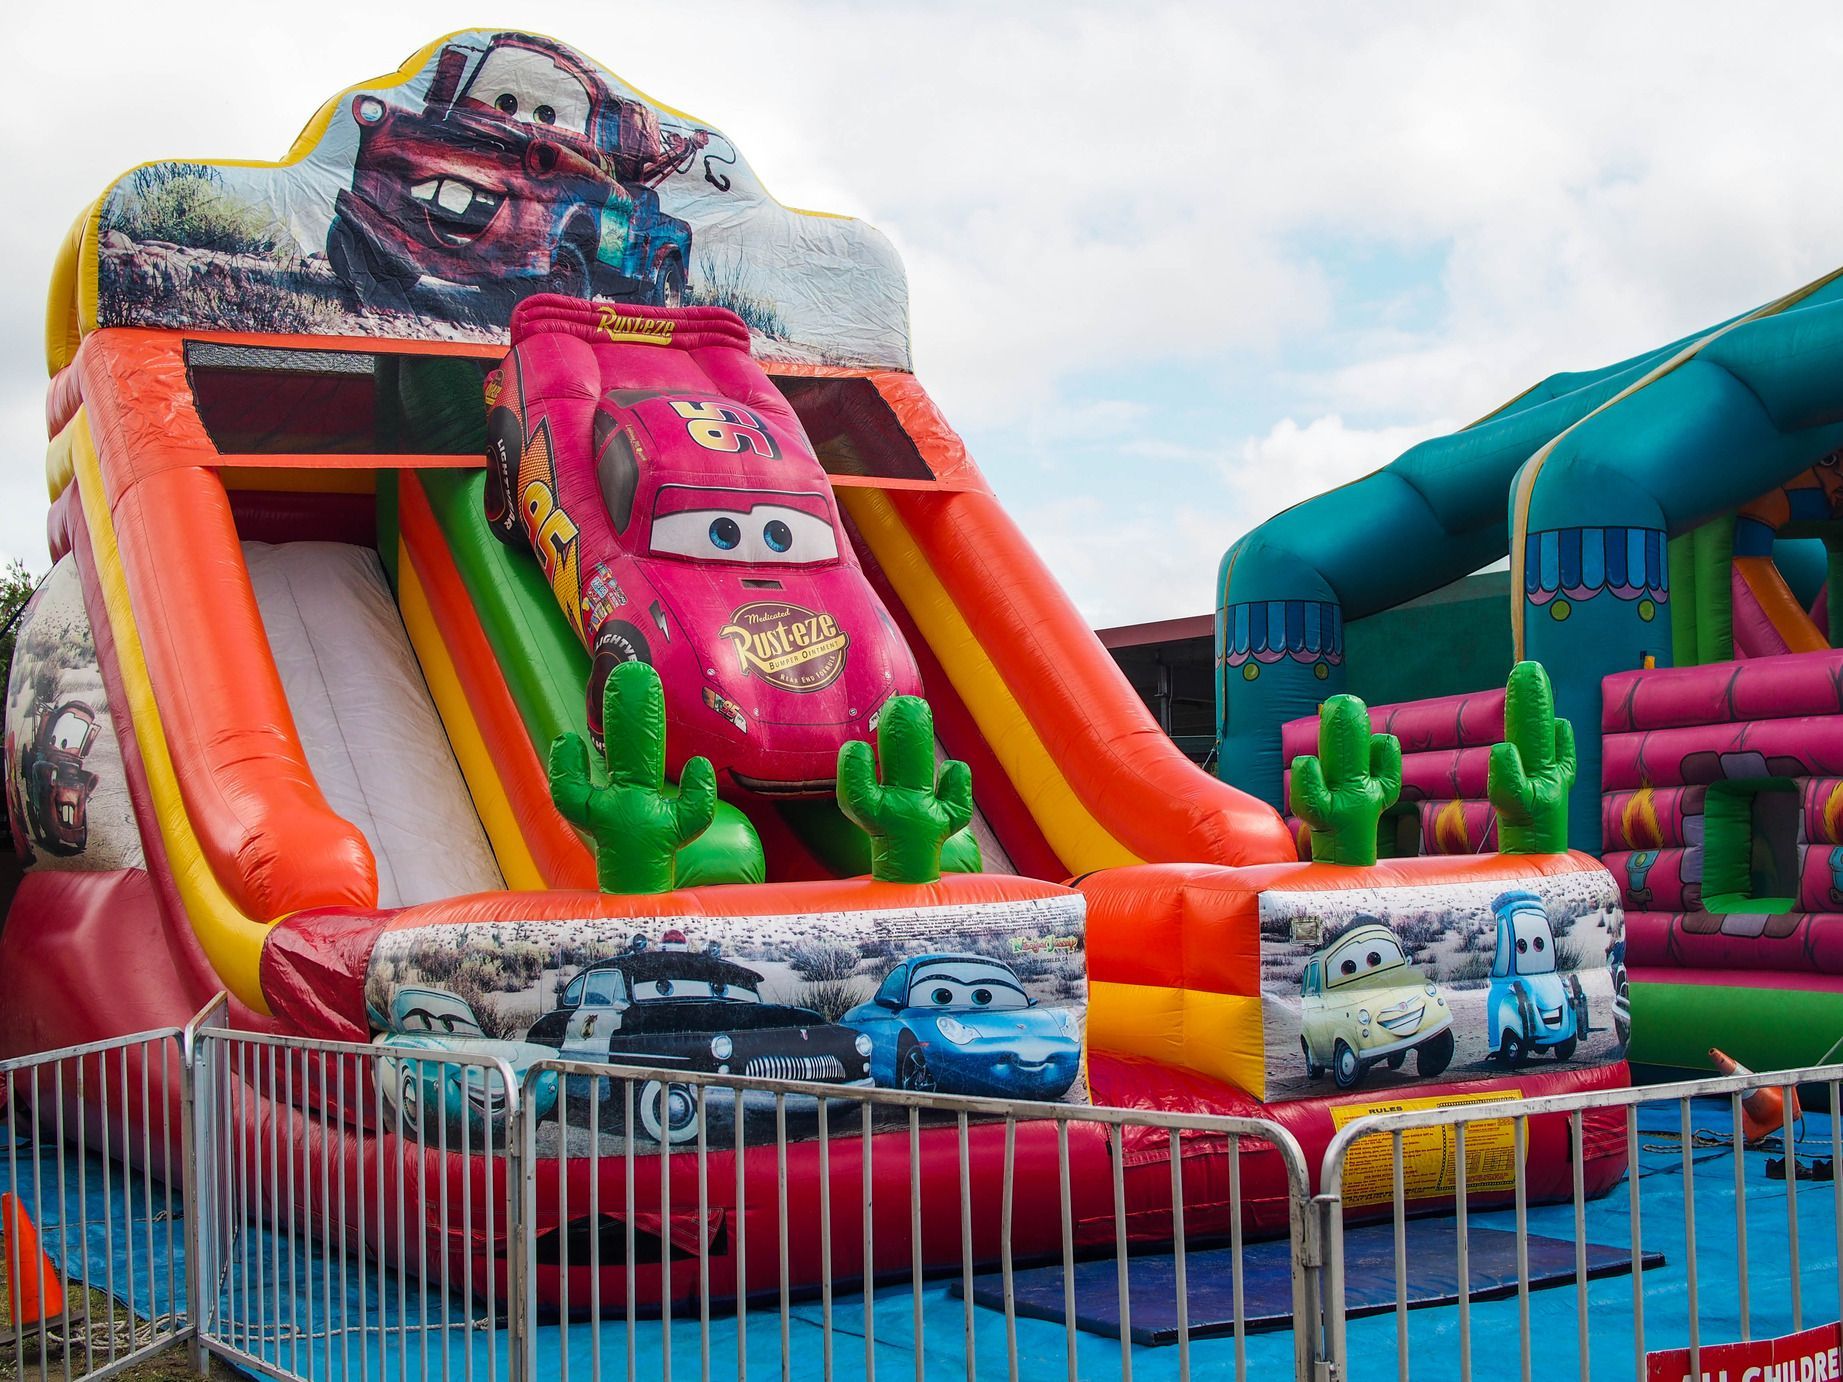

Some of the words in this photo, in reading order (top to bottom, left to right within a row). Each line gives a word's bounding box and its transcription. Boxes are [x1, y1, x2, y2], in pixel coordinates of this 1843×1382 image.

[521, 481, 579, 588] 95
[744, 608, 791, 624] Medicated
[594, 634, 638, 661] LIGHTYE
[769, 655, 799, 671] BUMPER
[801, 641, 839, 659] OINTMENT
[780, 673, 798, 684] REAR
[801, 676, 815, 684] END
[816, 656, 836, 679] FORMULA
[1368, 1106, 1403, 1114] RULES
[1742, 1346, 1842, 1382] CHILDRE
